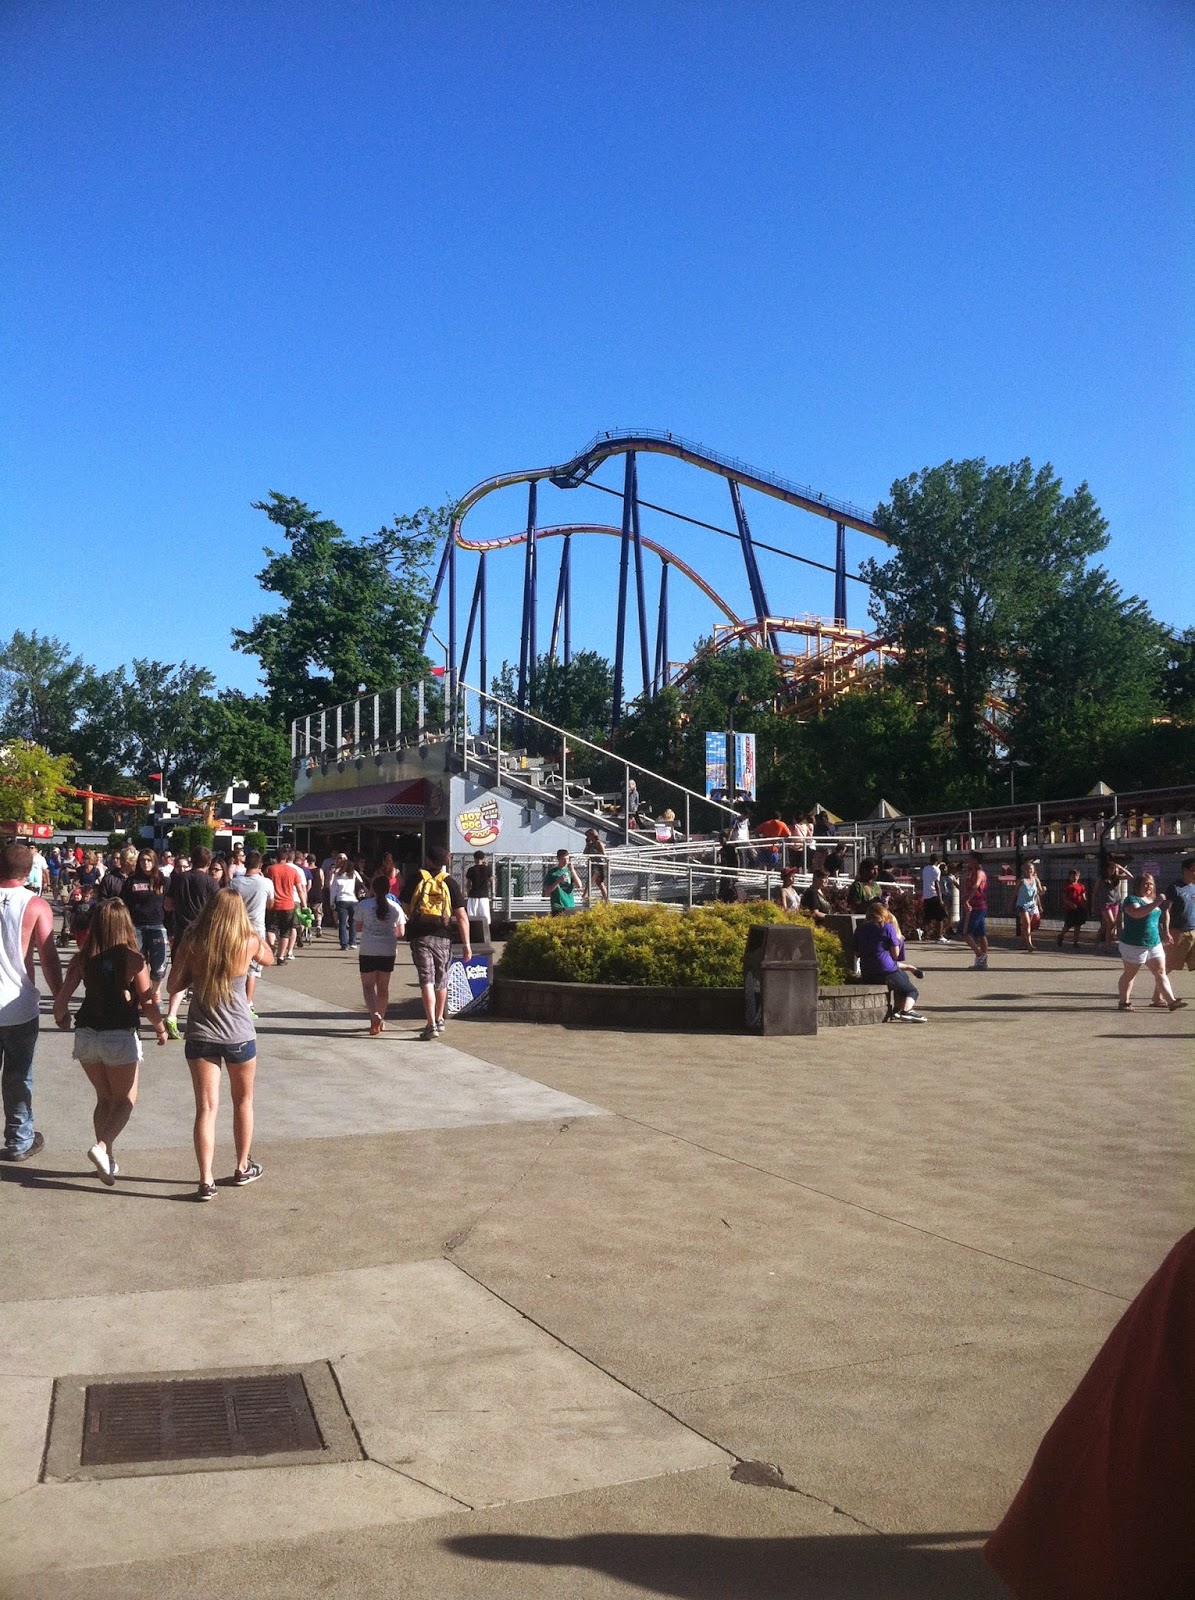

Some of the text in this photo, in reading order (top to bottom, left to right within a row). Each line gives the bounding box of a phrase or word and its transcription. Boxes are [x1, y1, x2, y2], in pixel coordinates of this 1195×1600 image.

[458, 812, 481, 822] HOT
[461, 820, 482, 830] DOG
[466, 965, 487, 974] Cedar
[467, 971, 487, 980] Point
